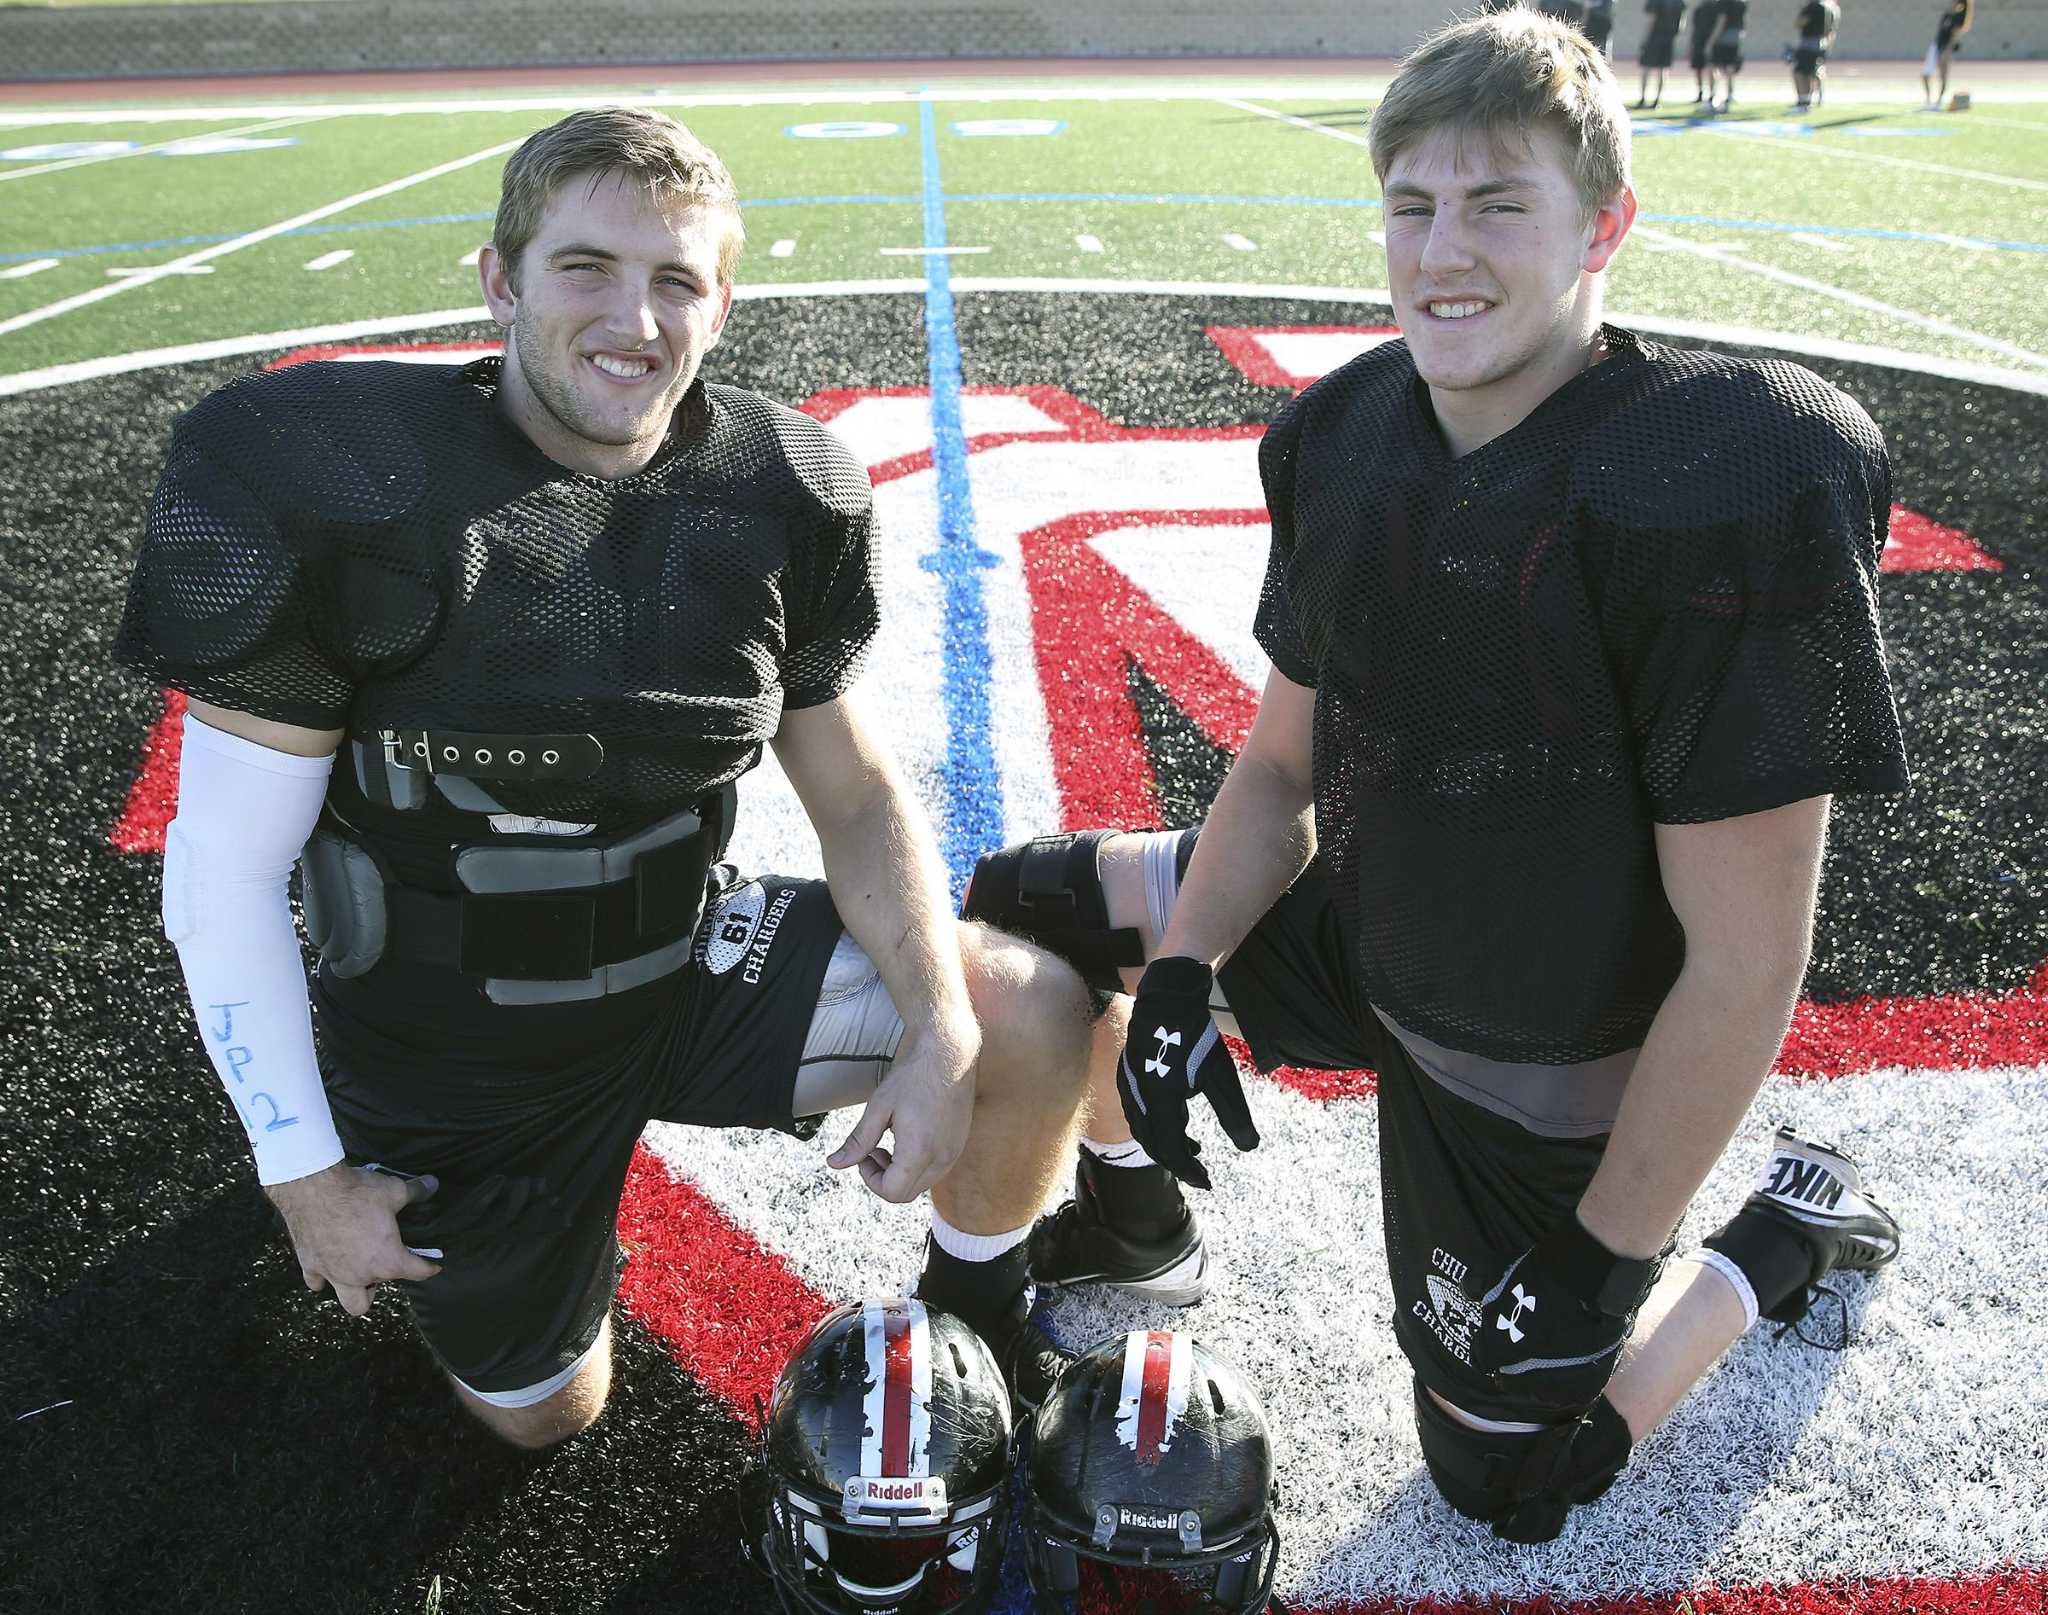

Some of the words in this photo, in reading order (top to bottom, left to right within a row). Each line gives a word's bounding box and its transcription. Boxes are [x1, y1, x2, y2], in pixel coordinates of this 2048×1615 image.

[720, 912, 752, 945] 61
[743, 888, 797, 985] CHARGERS
[1761, 1157, 1846, 1211] NIKE
[867, 1481, 923, 1501] Riddell
[1120, 1508, 1178, 1530] Riddell
